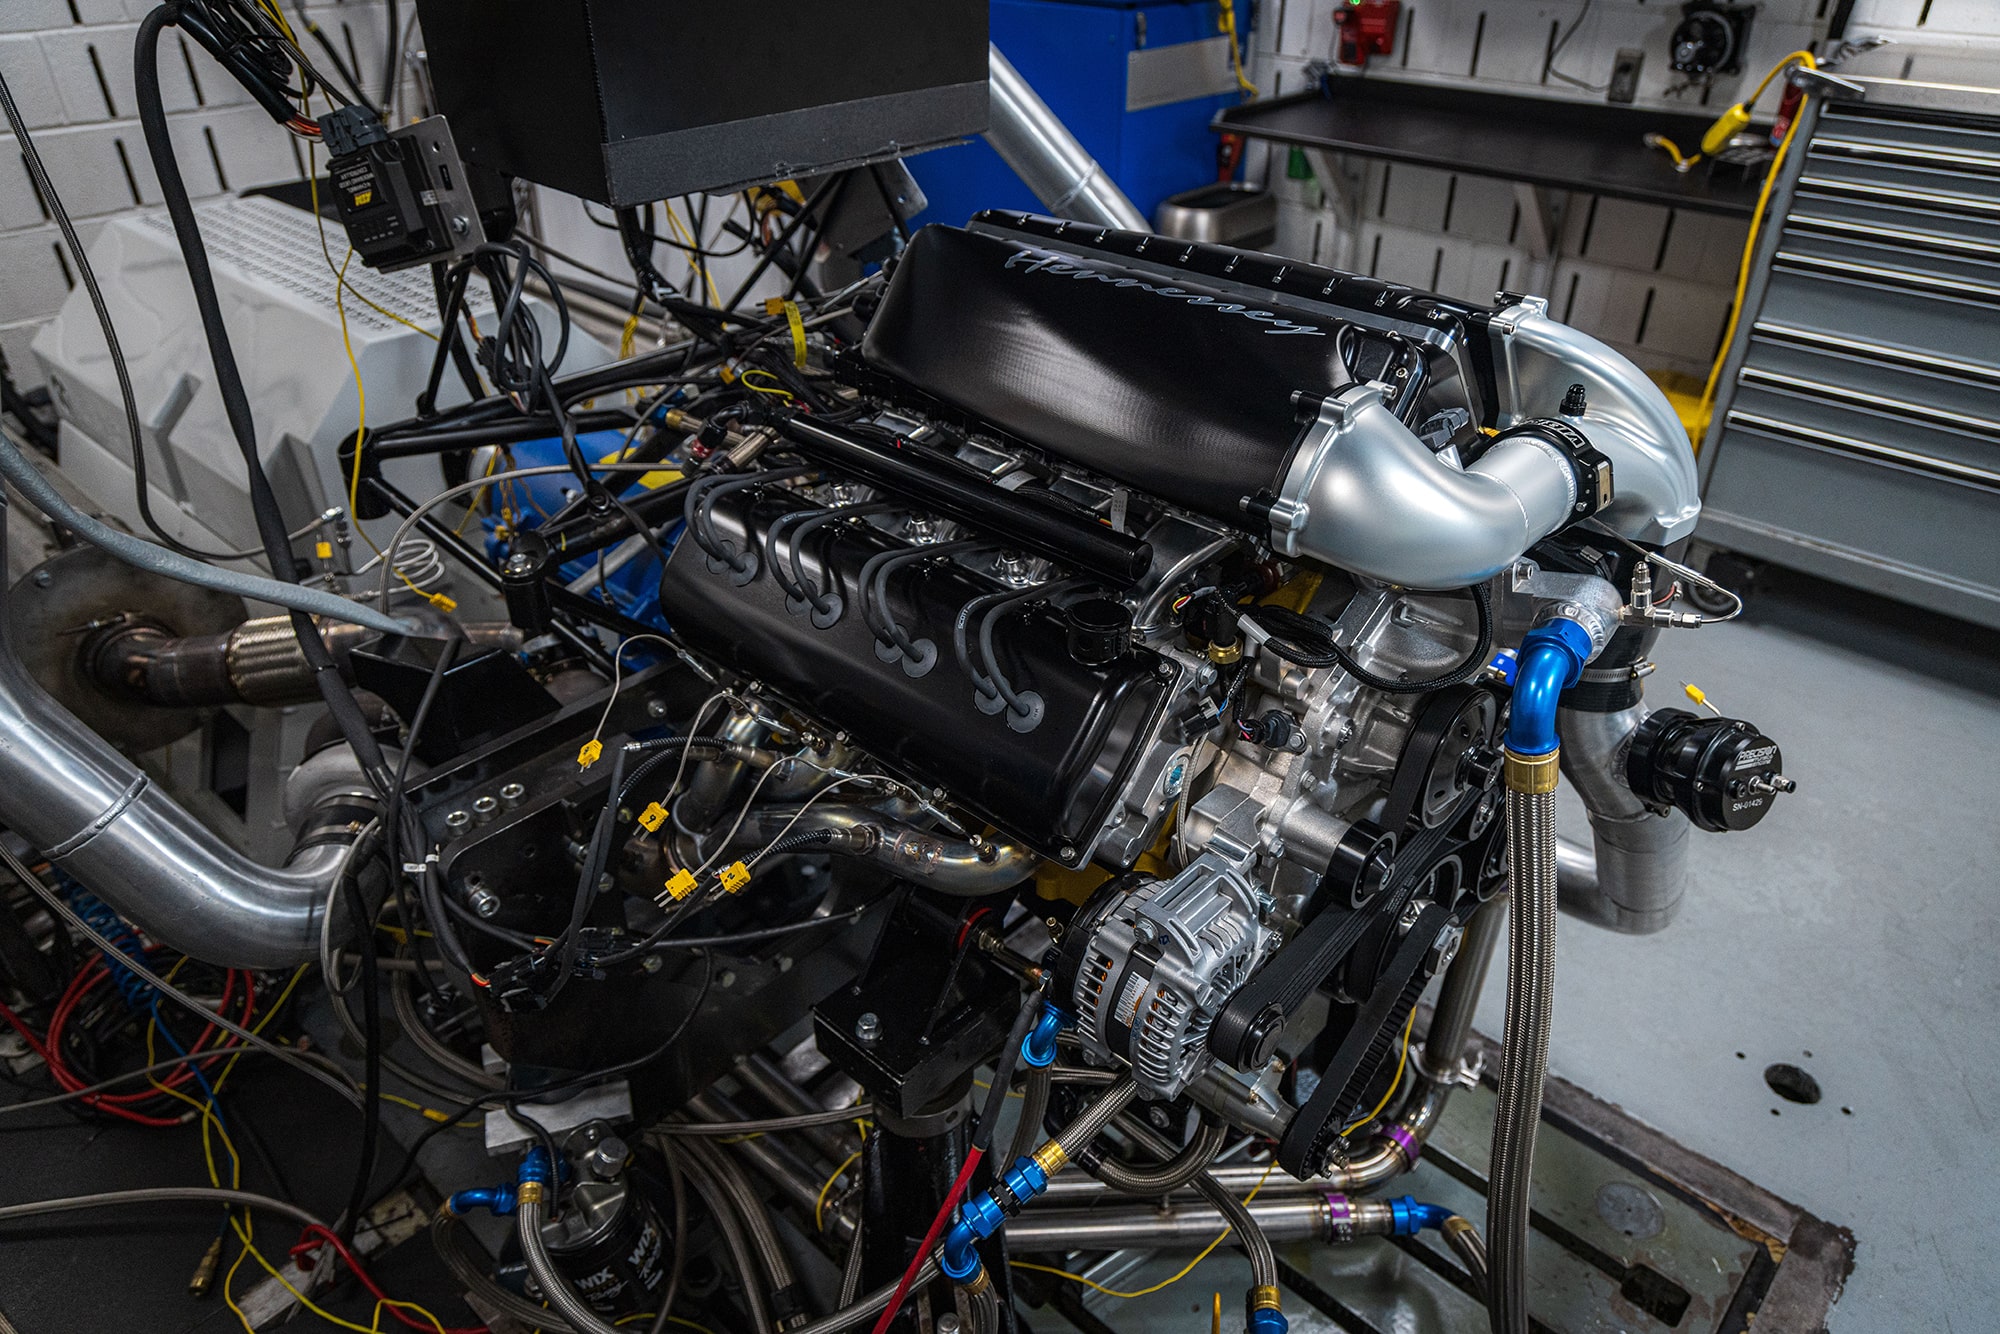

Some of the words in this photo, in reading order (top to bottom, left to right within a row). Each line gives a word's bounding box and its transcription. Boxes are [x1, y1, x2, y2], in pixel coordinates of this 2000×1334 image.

[1004, 250, 1326, 336] Hennessey
[957, 608, 968, 630] SCOTT
[1738, 745, 1777, 760] PRECISION
[574, 1265, 614, 1289] WIX
